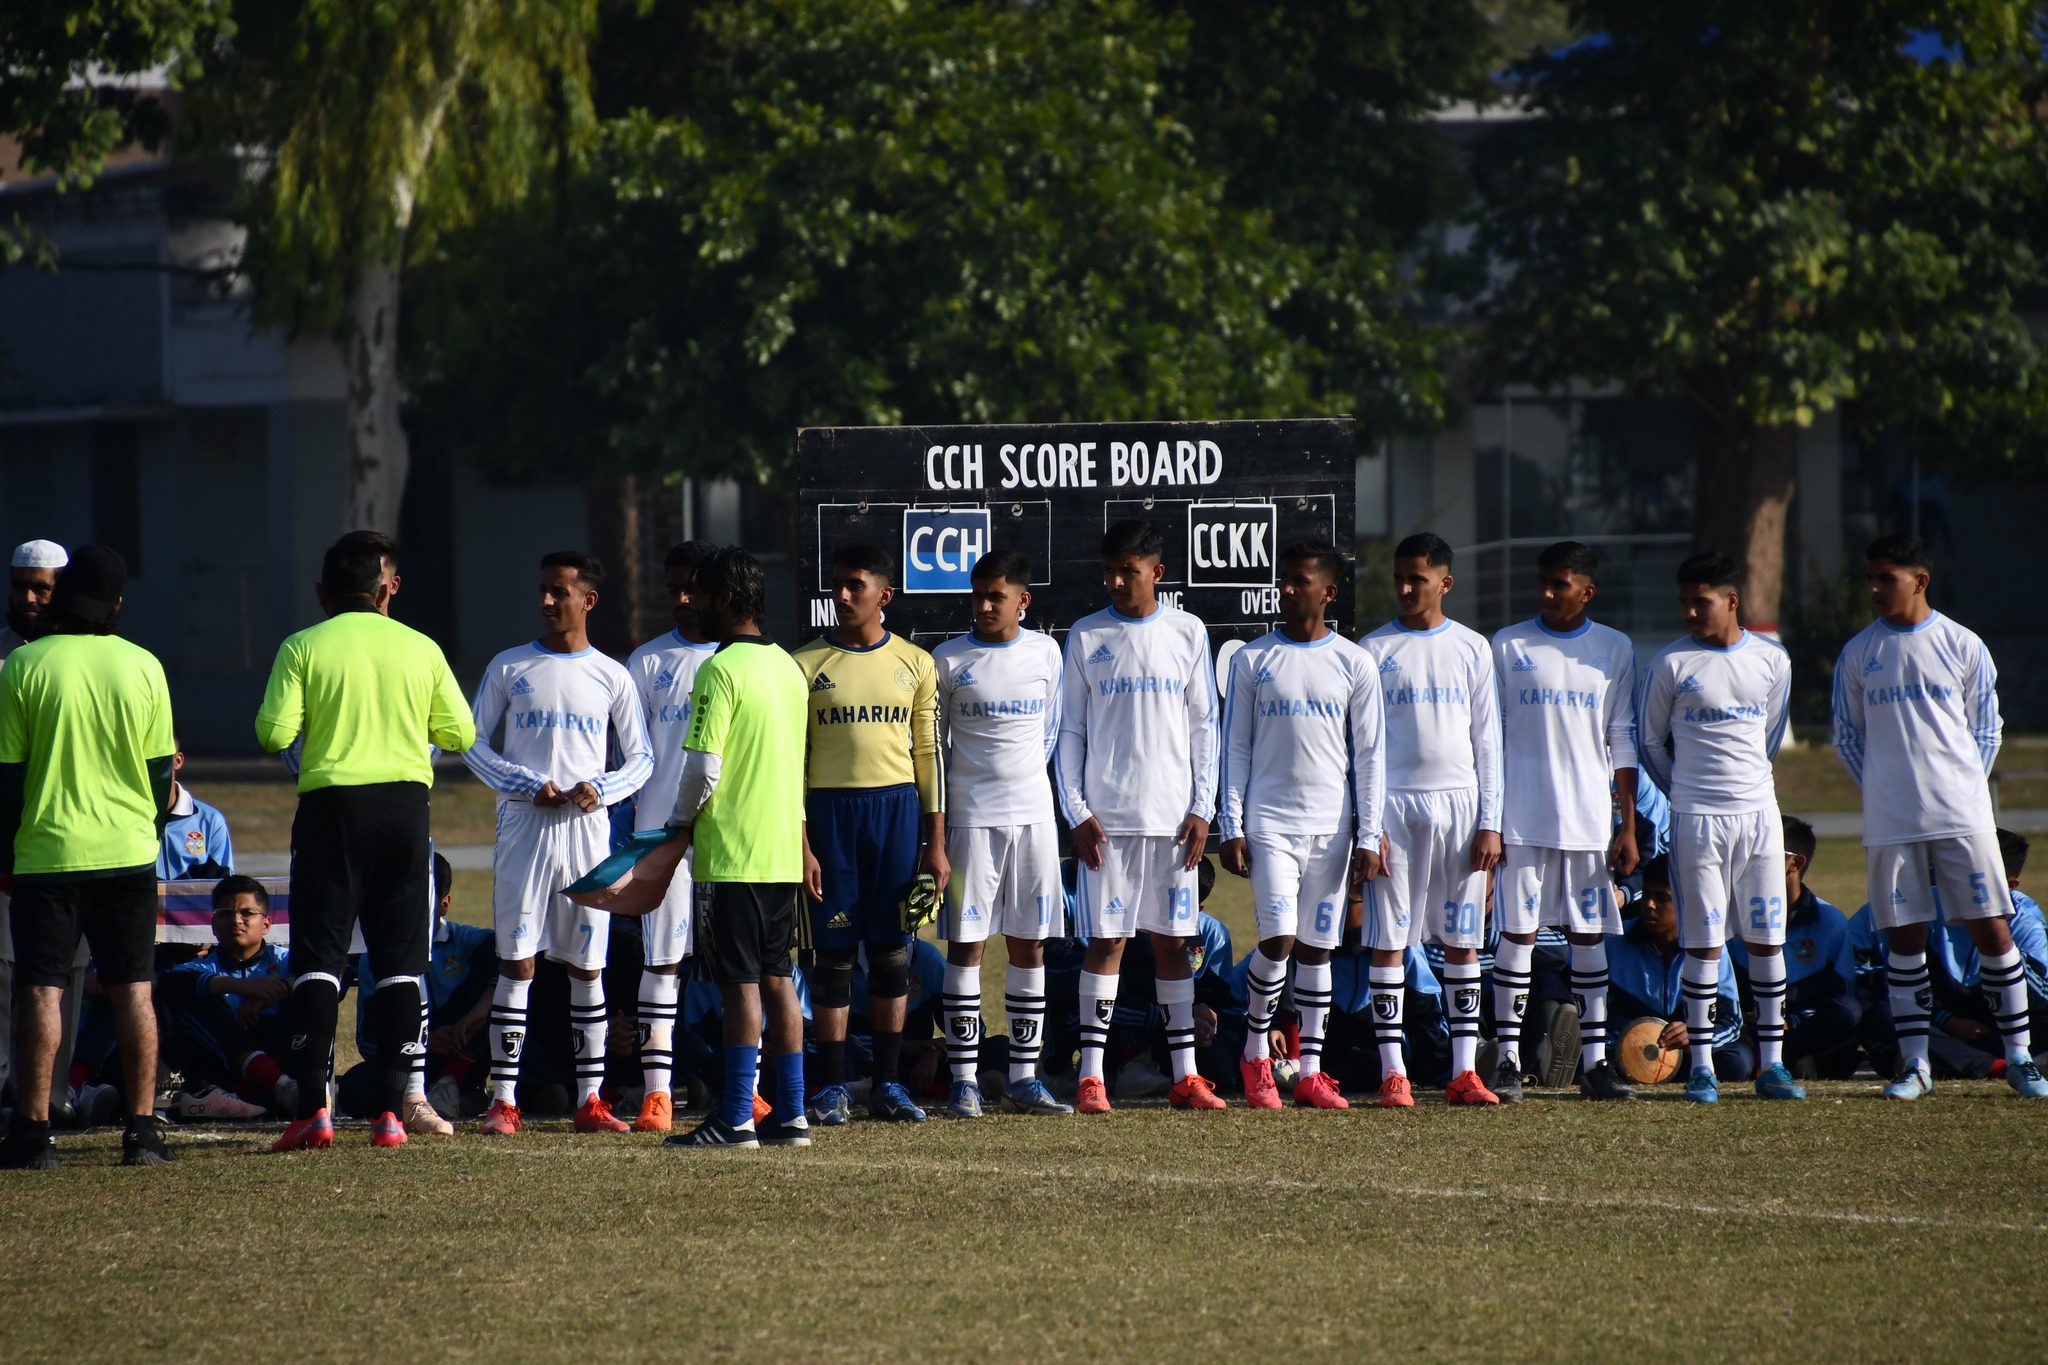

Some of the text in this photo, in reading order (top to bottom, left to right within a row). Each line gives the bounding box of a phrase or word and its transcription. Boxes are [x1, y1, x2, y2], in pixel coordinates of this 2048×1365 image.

[927, 440, 1223, 489] CCH SCORE BOARD
[910, 526, 983, 572] CCH
[1193, 522, 1271, 569] CCKK
[1241, 588, 1281, 615] OVER
[1088, 654, 1115, 665] adidas
[1099, 676, 1181, 696] KAHARIAN
[816, 705, 910, 725] KAHARIAN
[1168, 887, 1191, 920] 19
[1581, 888, 1607, 919] 21
[1969, 872, 1990, 904] 5
[1315, 902, 1333, 933] 6
[1444, 901, 1475, 935] 30
[1750, 896, 1782, 929] 22
[580, 924, 595, 954] 7
